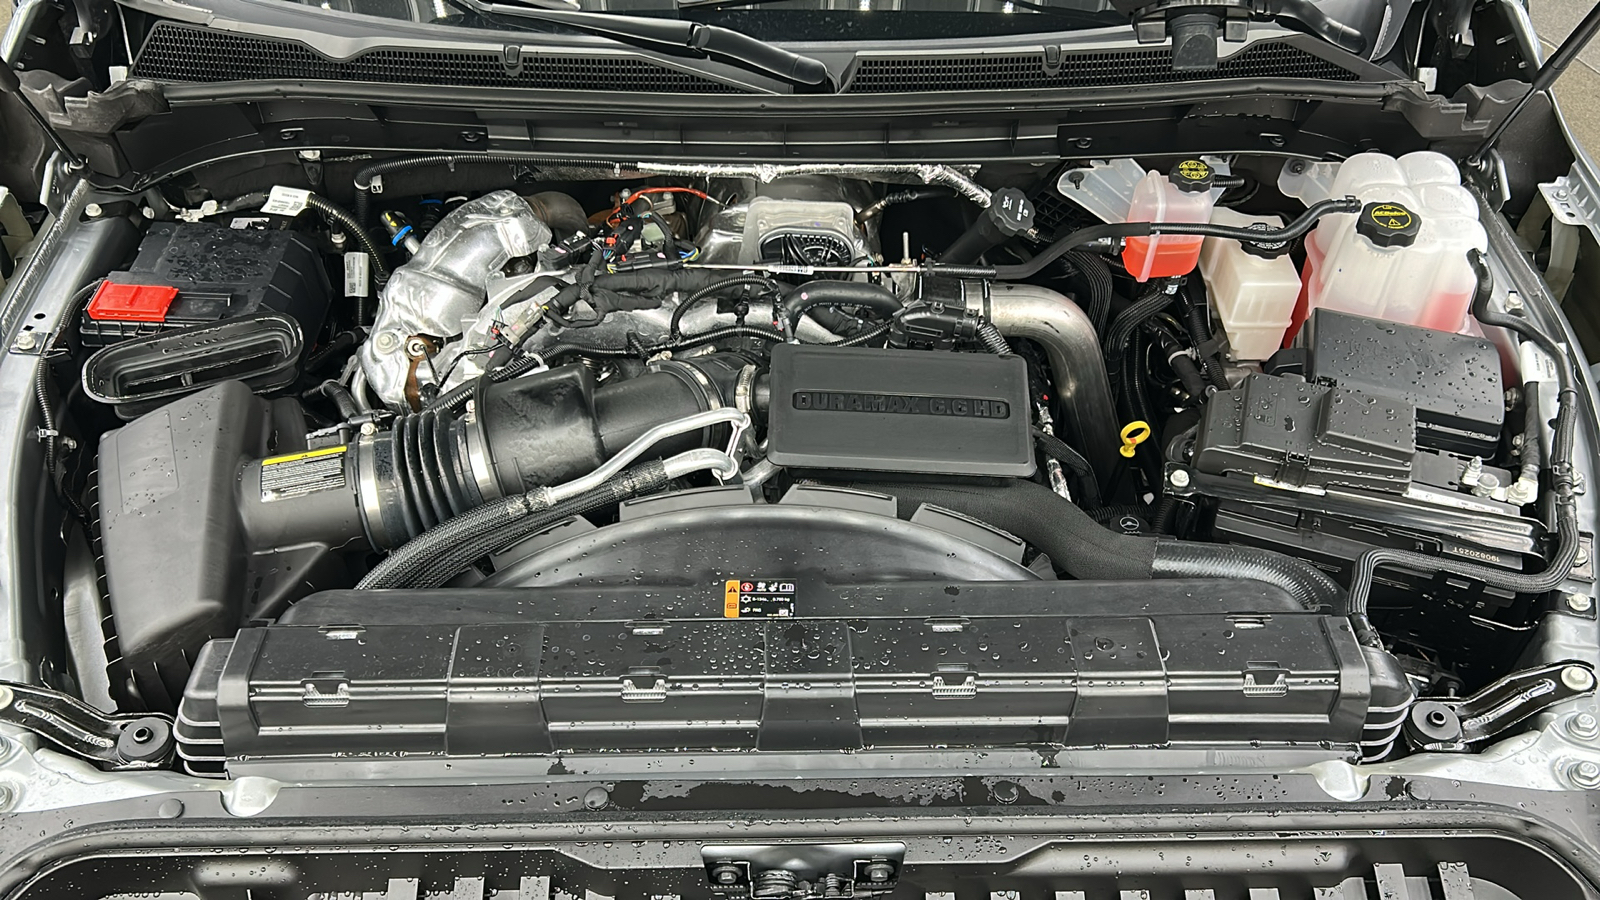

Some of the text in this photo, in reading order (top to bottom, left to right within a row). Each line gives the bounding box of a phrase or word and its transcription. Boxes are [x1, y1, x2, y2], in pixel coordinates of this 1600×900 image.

[795, 392, 1007, 418] DURAMAX 6.6 HD
[1452, 546, 1501, 563] 19082025T
